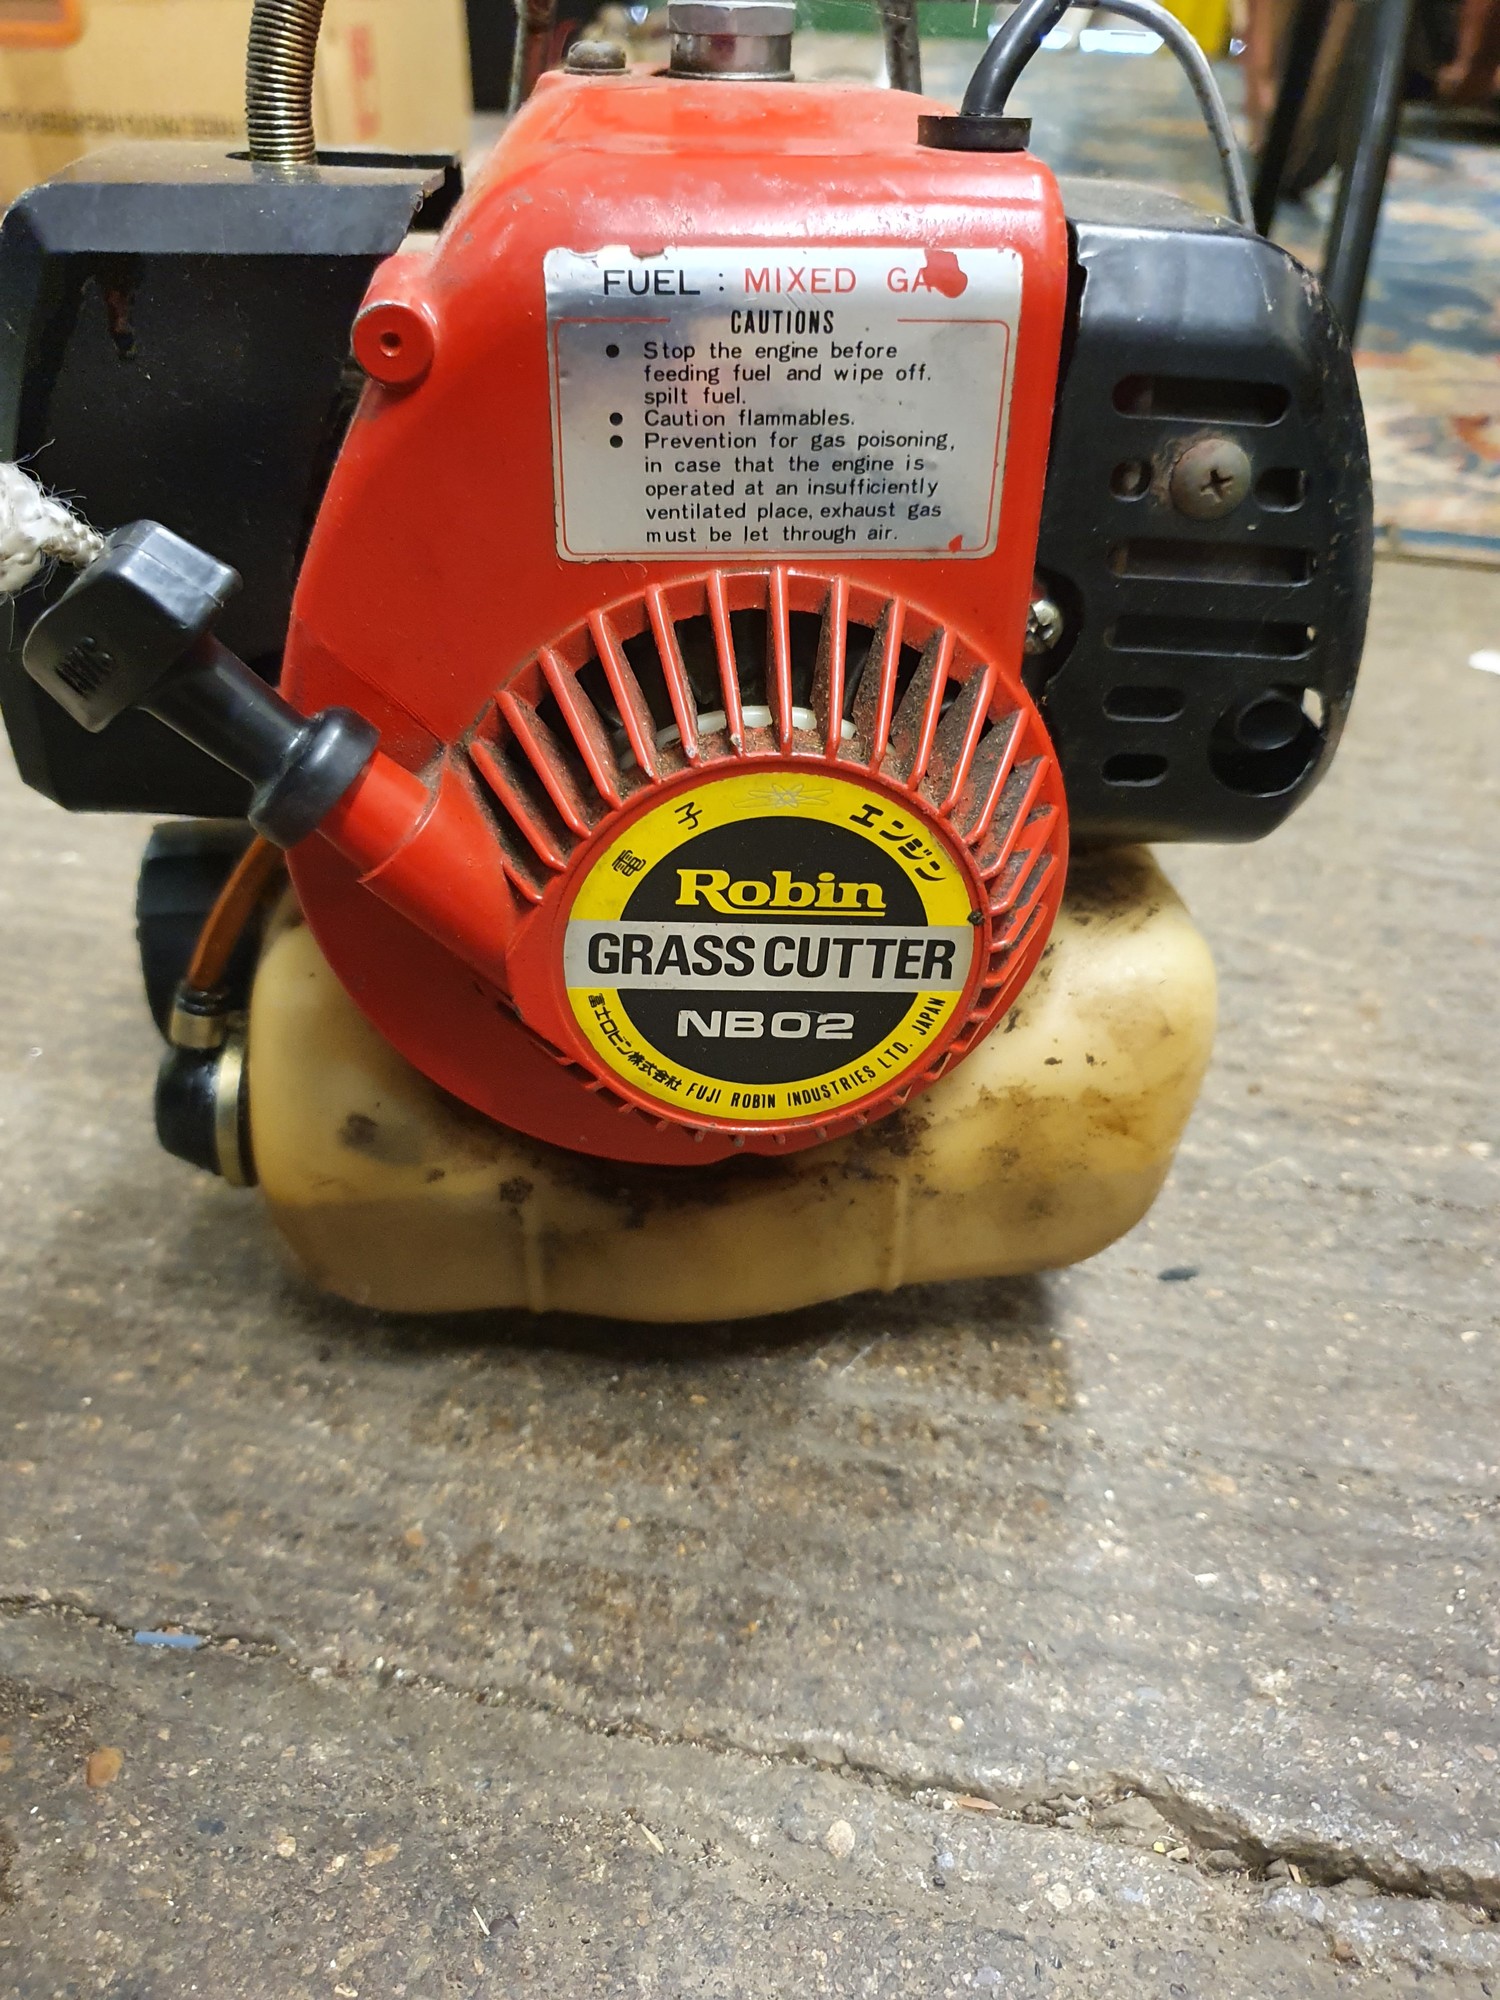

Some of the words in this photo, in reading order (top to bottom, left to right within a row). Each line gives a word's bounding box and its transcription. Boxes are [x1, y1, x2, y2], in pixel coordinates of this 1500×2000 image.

[603, 269, 700, 295] FUEL
[745, 267, 856, 294] MIXED
[887, 267, 950, 294] GA
[731, 310, 835, 334] CAUTIONS
[644, 342, 695, 362] Stop
[710, 342, 742, 359] the
[755, 344, 818, 362] engine
[831, 341, 897, 359] before
[644, 365, 720, 385] feeding
[733, 365, 770, 381] fuel
[787, 365, 821, 381] and
[834, 365, 883, 385] wipe
[896, 365, 930, 381] off.
[644, 387, 688, 408] spilt
[703, 387, 746, 404] fuel.
[645, 409, 725, 427] Caution
[738, 408, 854, 426] flammables.
[645, 432, 756, 449] Prevention
[770, 432, 798, 448] for
[811, 434, 845, 451] gas
[858, 431, 954, 451] poisoning,
[645, 456, 662, 473] in
[675, 461, 720, 473] case
[735, 456, 774, 472] that
[789, 455, 819, 472] the
[832, 456, 894, 475] engine
[906, 455, 924, 471] is
[646, 479, 734, 499] operated
[745, 480, 764, 496] at
[776, 484, 798, 495] an
[808, 478, 938, 498] insufficiently
[646, 502, 746, 520] ventilated
[758, 502, 812, 522] place,
[820, 502, 895, 518] exhaust
[908, 504, 941, 520] gas
[647, 527, 696, 543] must
[710, 526, 732, 542] be
[744, 525, 768, 542] let
[783, 525, 856, 544] through
[868, 525, 897, 540] air.
[675, 869, 886, 917] Robin
[588, 932, 755, 977] GRASS
[764, 936, 956, 980] CUTTER
[686, 1083, 721, 1104] FUJI
[731, 1092, 776, 1108] ROBIN
[787, 1065, 876, 1107] INDUSTRIES
[877, 1041, 913, 1069] LTD.
[912, 997, 946, 1035] JAPAN
